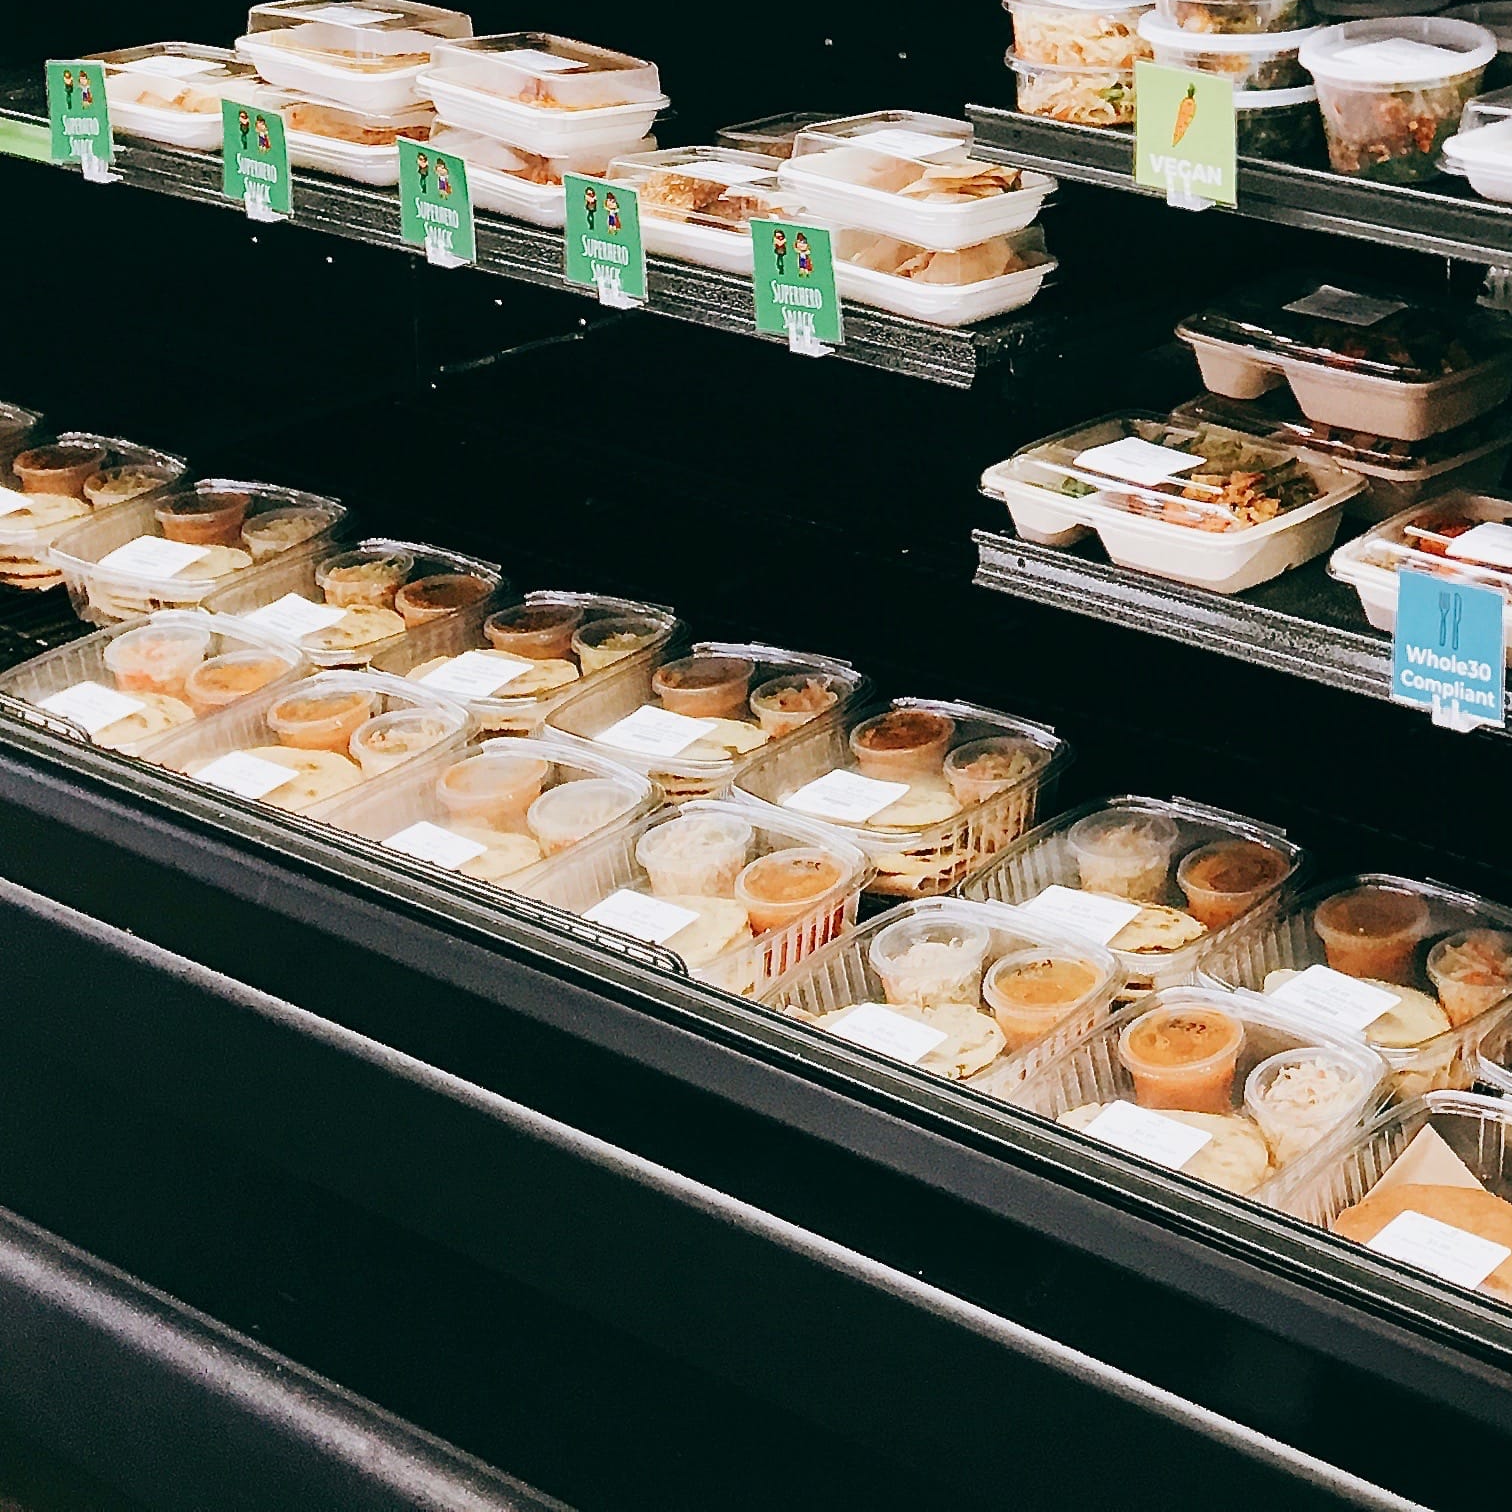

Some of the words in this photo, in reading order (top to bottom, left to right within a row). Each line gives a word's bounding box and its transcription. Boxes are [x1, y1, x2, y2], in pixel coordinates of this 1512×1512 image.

[1149, 152, 1222, 186] VEGAN
[581, 234, 629, 266] SUPERHERO
[771, 279, 822, 310] SUPERHERO
[1406, 644, 1492, 682] Whole30
[1401, 669, 1496, 708] Compliant
